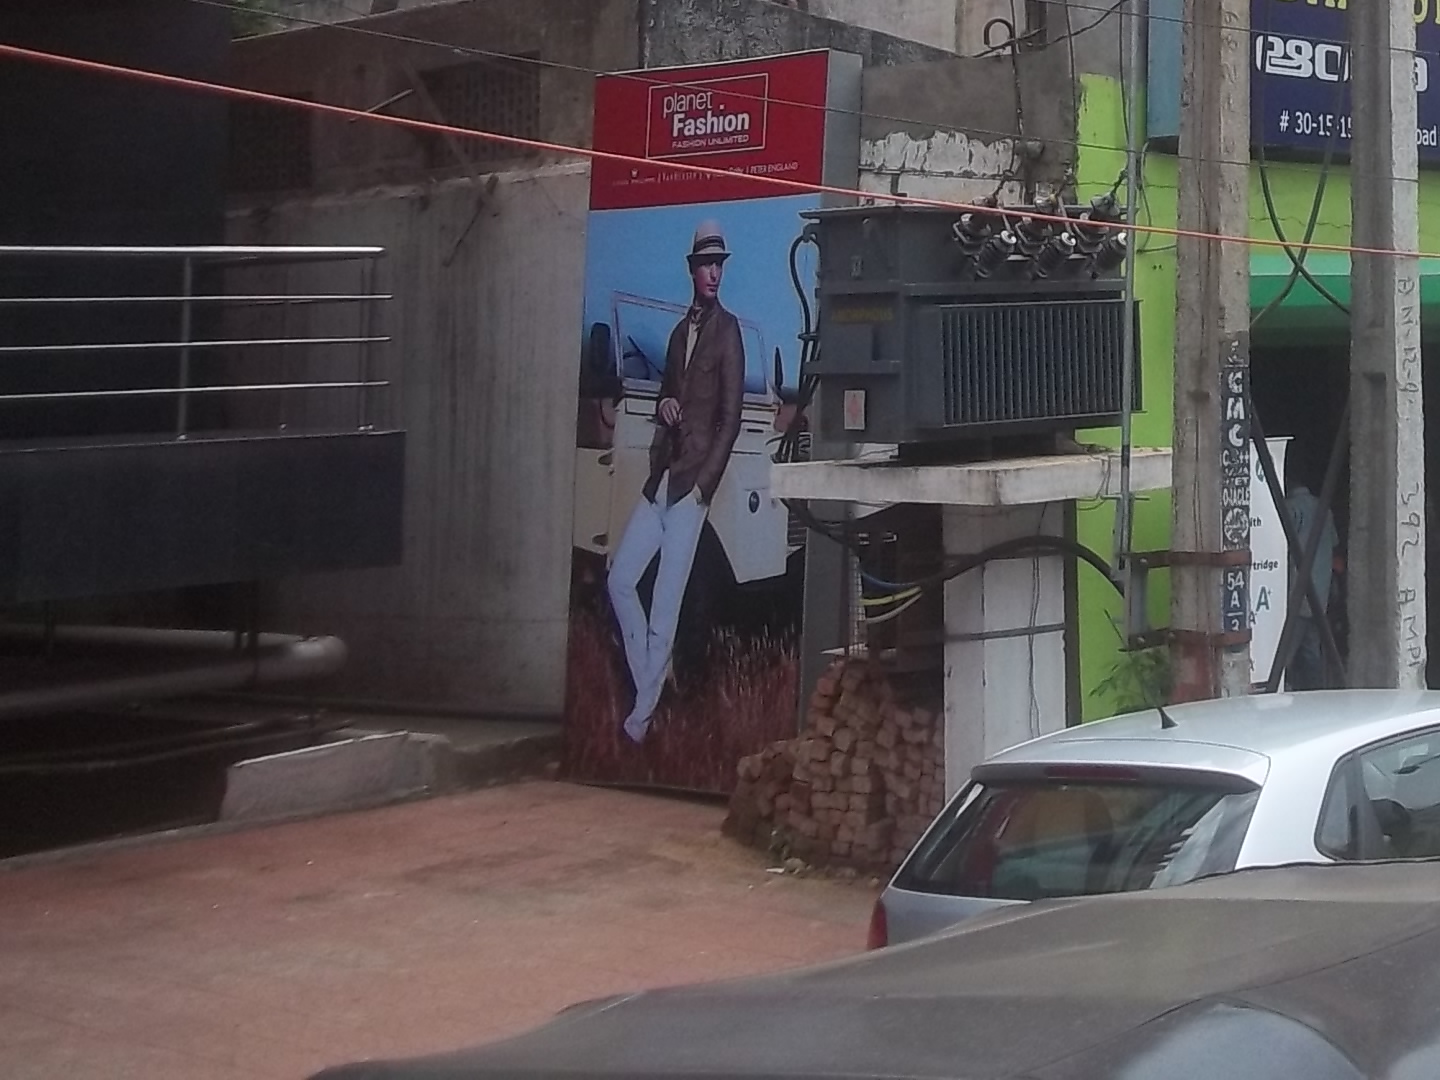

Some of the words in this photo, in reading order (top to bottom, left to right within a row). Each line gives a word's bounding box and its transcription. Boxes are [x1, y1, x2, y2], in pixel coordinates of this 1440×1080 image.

[663, 91, 713, 119] planet
[672, 104, 750, 137] Fashion
[672, 139, 706, 149] FASHION
[707, 134, 750, 146] UNLIMITED
[750, 164, 767, 175] PETER
[767, 161, 799, 173] ENGLAND
[1227, 570, 1245, 591] 54
